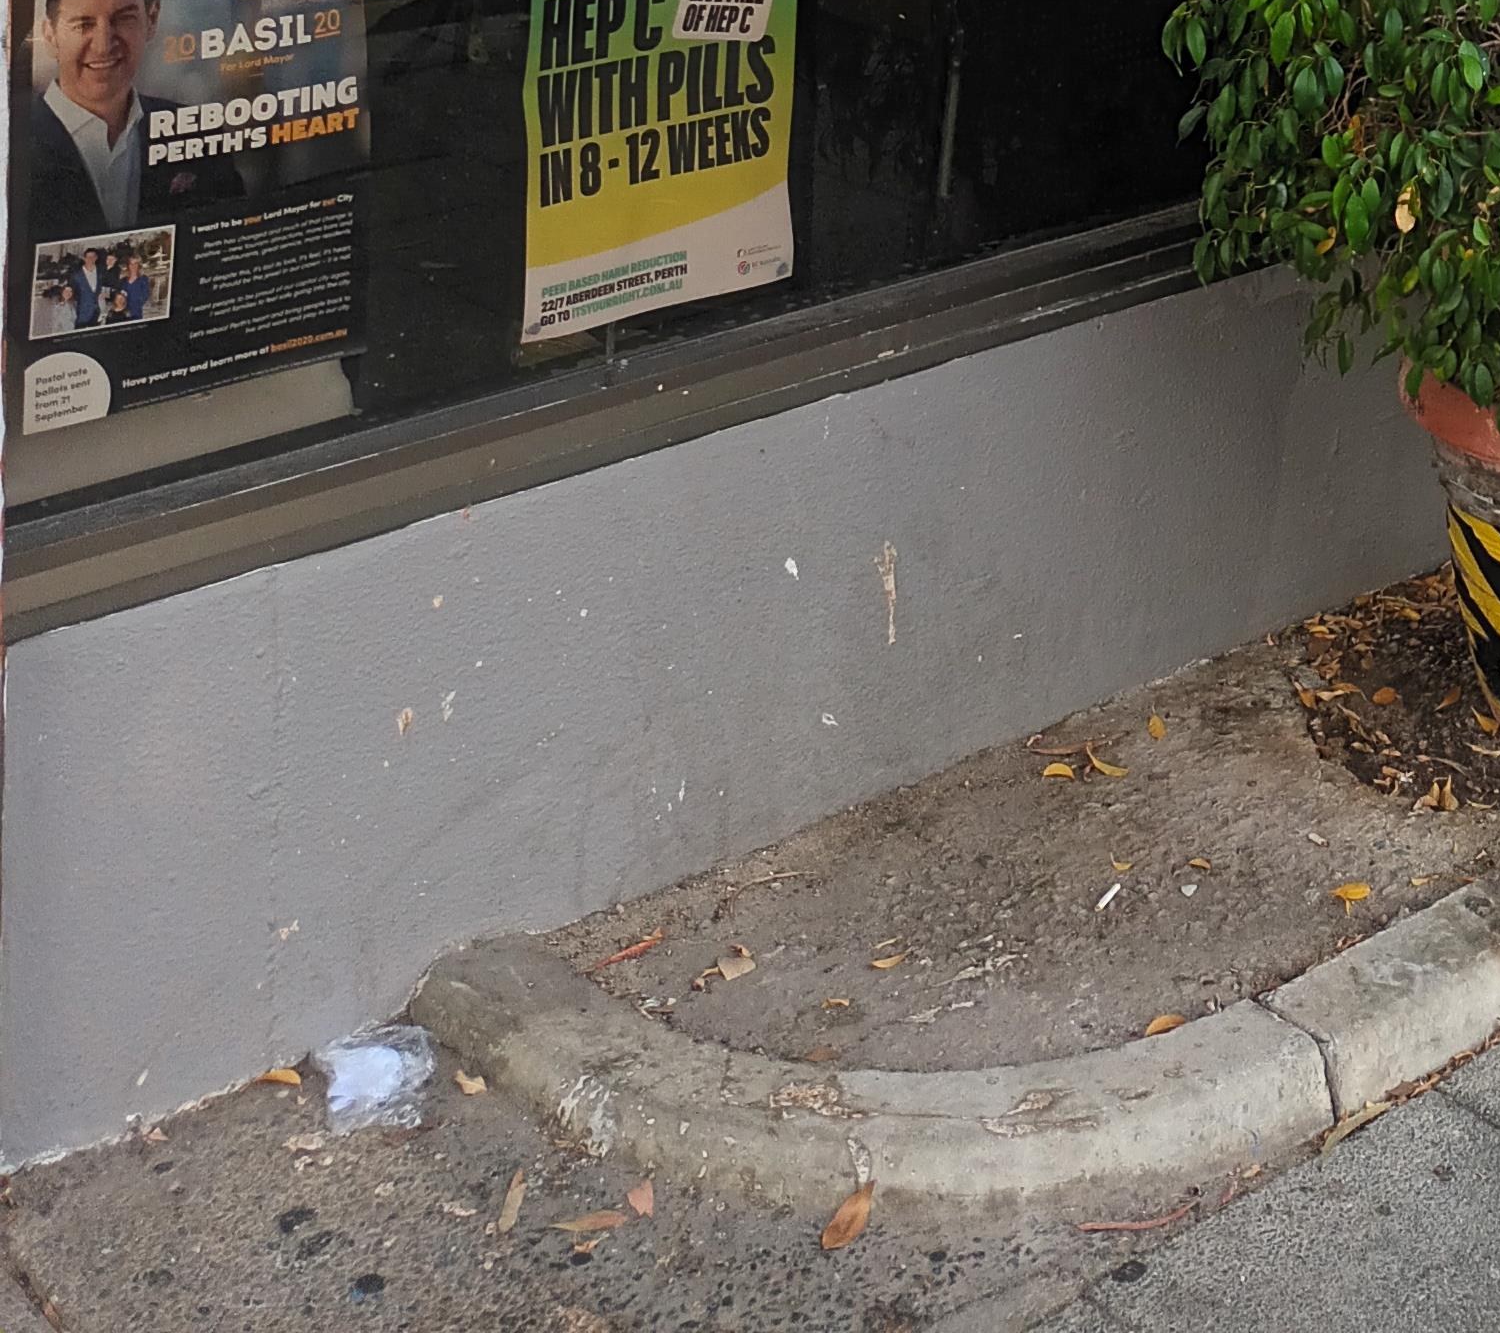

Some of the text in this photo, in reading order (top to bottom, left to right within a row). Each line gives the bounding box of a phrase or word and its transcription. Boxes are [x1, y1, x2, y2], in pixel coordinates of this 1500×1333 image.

[201, 14, 312, 60] BASIL
[314, 8, 341, 36] 20
[682, 4, 755, 34] OF HEP C
[264, 53, 295, 66] Mayor
[149, 76, 358, 139] REBOOTING
[537, 34, 776, 147] WITH PILLS
[149, 107, 360, 166] PERTH'S HEART
[540, 147, 574, 209] IN
[579, 142, 601, 198] 8
[625, 128, 661, 186] 12
[667, 107, 771, 176] WEEKS
[197, 222, 219, 233] want
[220, 220, 230, 229] to
[231, 218, 242, 227] be
[263, 209, 282, 221] Lord
[283, 204, 309, 217] Mayor
[336, 194, 354, 203] City
[541, 264, 688, 314] 22/7 ABERDEEN STREET, PERTH
[542, 250, 688, 298] PEER BASED HARM REDUCTION
[540, 313, 556, 327] GO
[557, 309, 571, 322] TO
[35, 366, 88, 386] Postal vote
[122, 375, 148, 389] Have
[148, 371, 170, 387] your
[171, 368, 188, 382] say
[189, 361, 209, 374] and
[210, 356, 234, 370] learn
[234, 351, 257, 363] more
[258, 345, 270, 356] at
[34, 397, 59, 411] from
[35, 378, 91, 398] ballots sent
[34, 403, 89, 423] September
